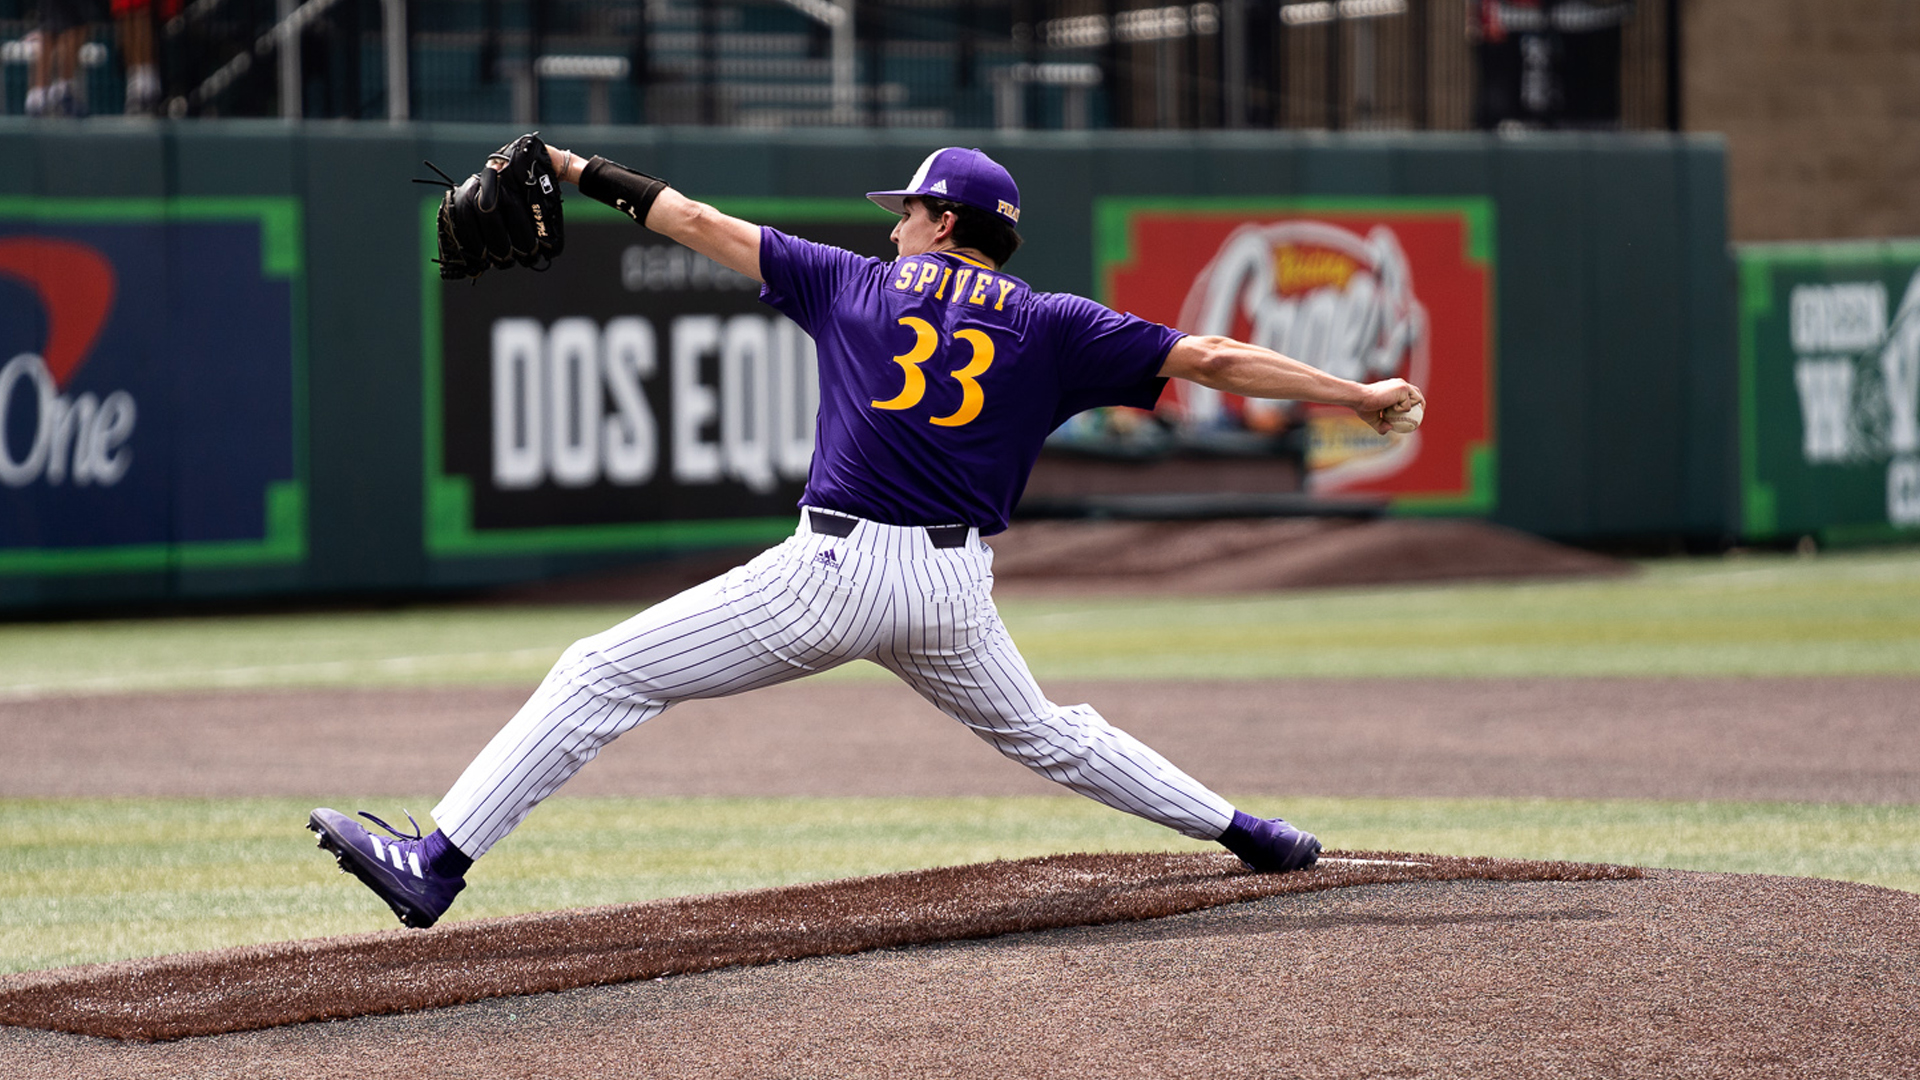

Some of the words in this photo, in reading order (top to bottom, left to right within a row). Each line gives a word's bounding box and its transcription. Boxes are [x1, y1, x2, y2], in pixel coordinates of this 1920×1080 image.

[895, 262, 1016, 311] SPIVEY
[0, 352, 137, 487] One
[491, 316, 657, 489] DOS
[870, 316, 995, 427] 33
